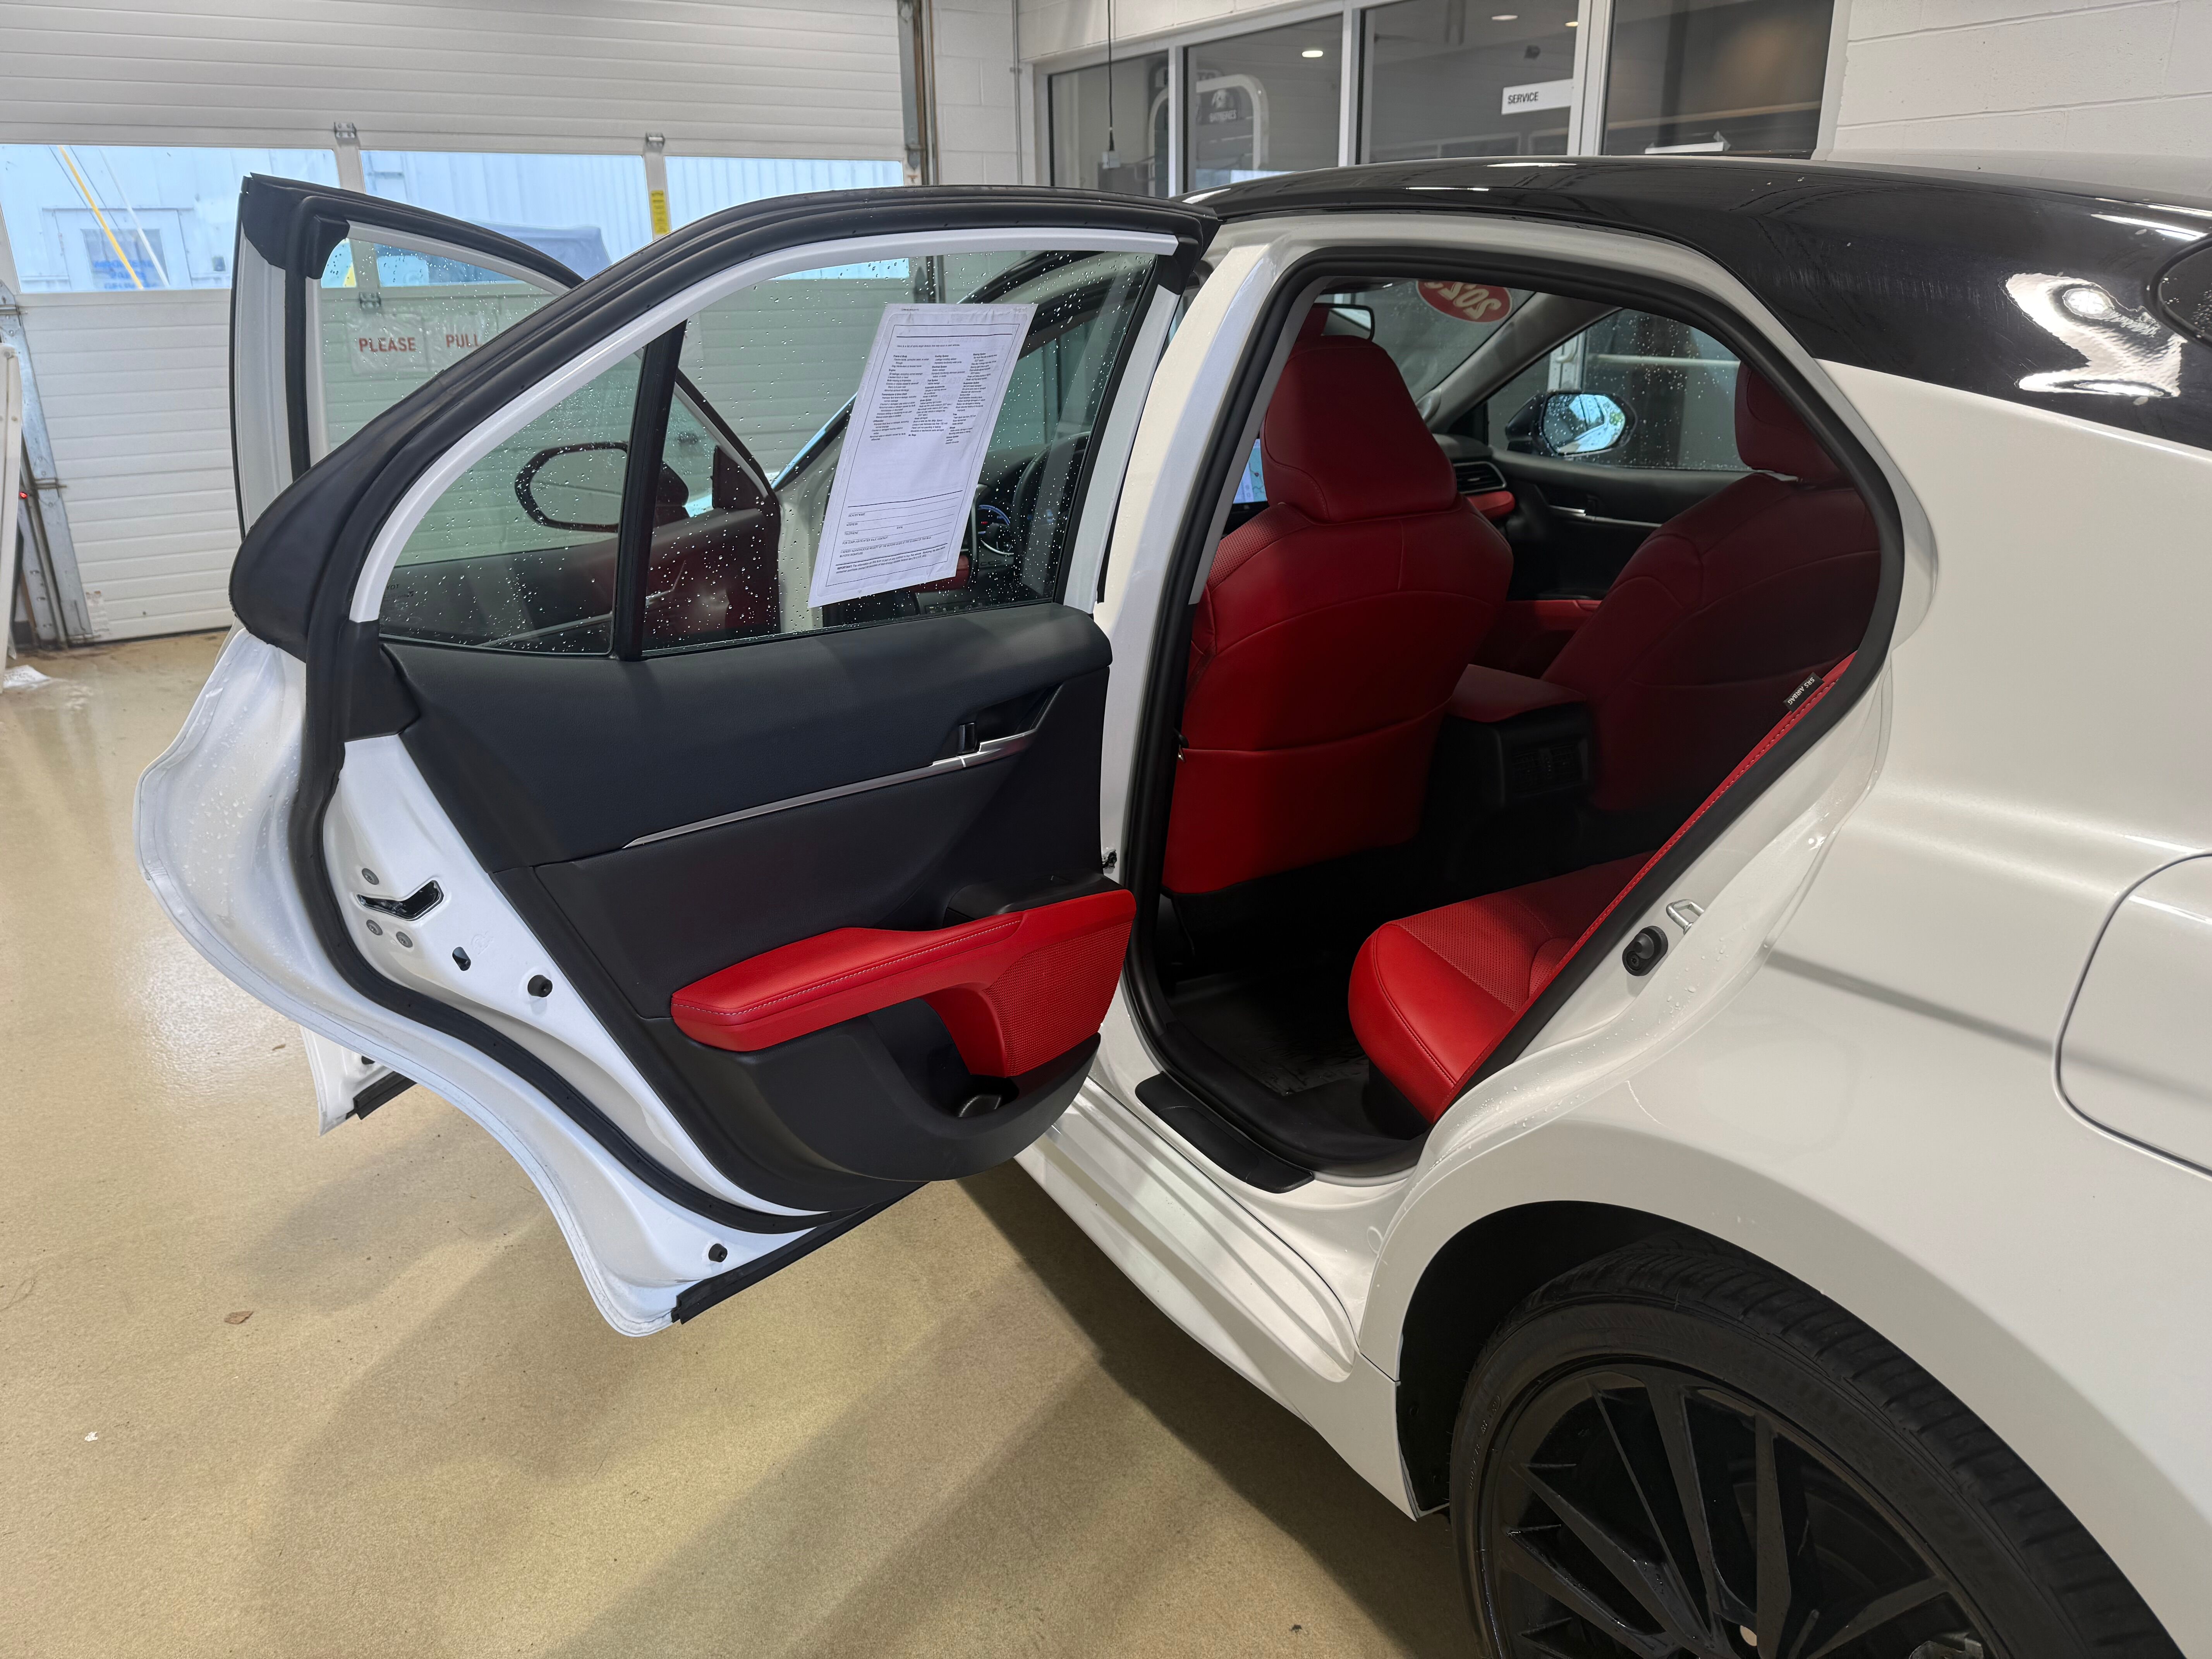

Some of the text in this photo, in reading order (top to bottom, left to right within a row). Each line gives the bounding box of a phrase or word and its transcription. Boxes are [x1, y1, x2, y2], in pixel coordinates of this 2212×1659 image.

[1508, 91, 1539, 105] SERVICE
[359, 334, 482, 352] PLEASE PULL
[1787, 677, 1815, 705] SRS AIRBAG
